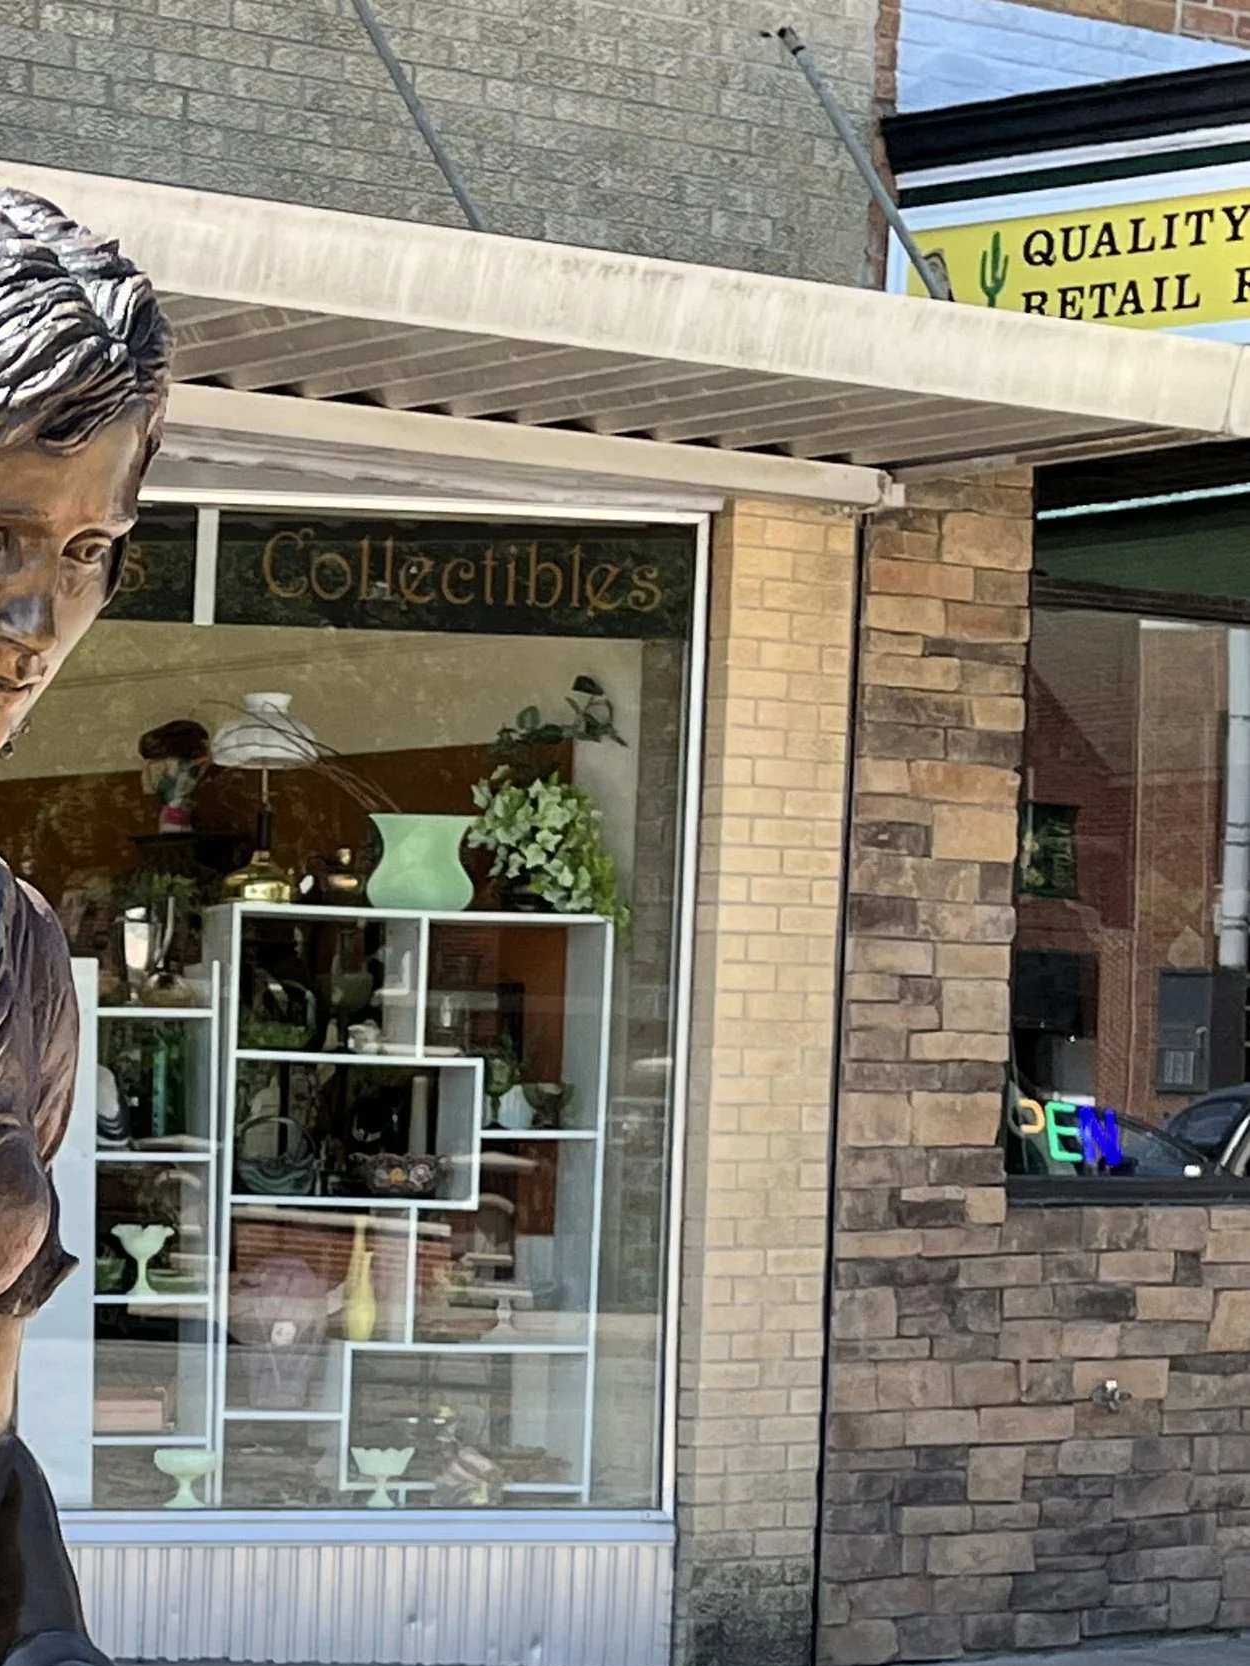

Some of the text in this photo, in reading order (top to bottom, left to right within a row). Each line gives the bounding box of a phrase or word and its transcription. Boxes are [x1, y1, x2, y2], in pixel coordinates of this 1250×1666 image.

[1022, 204, 1250, 267] QUALITY
[1021, 273, 1200, 320] RETAIL
[262, 527, 663, 617] Collectibles
